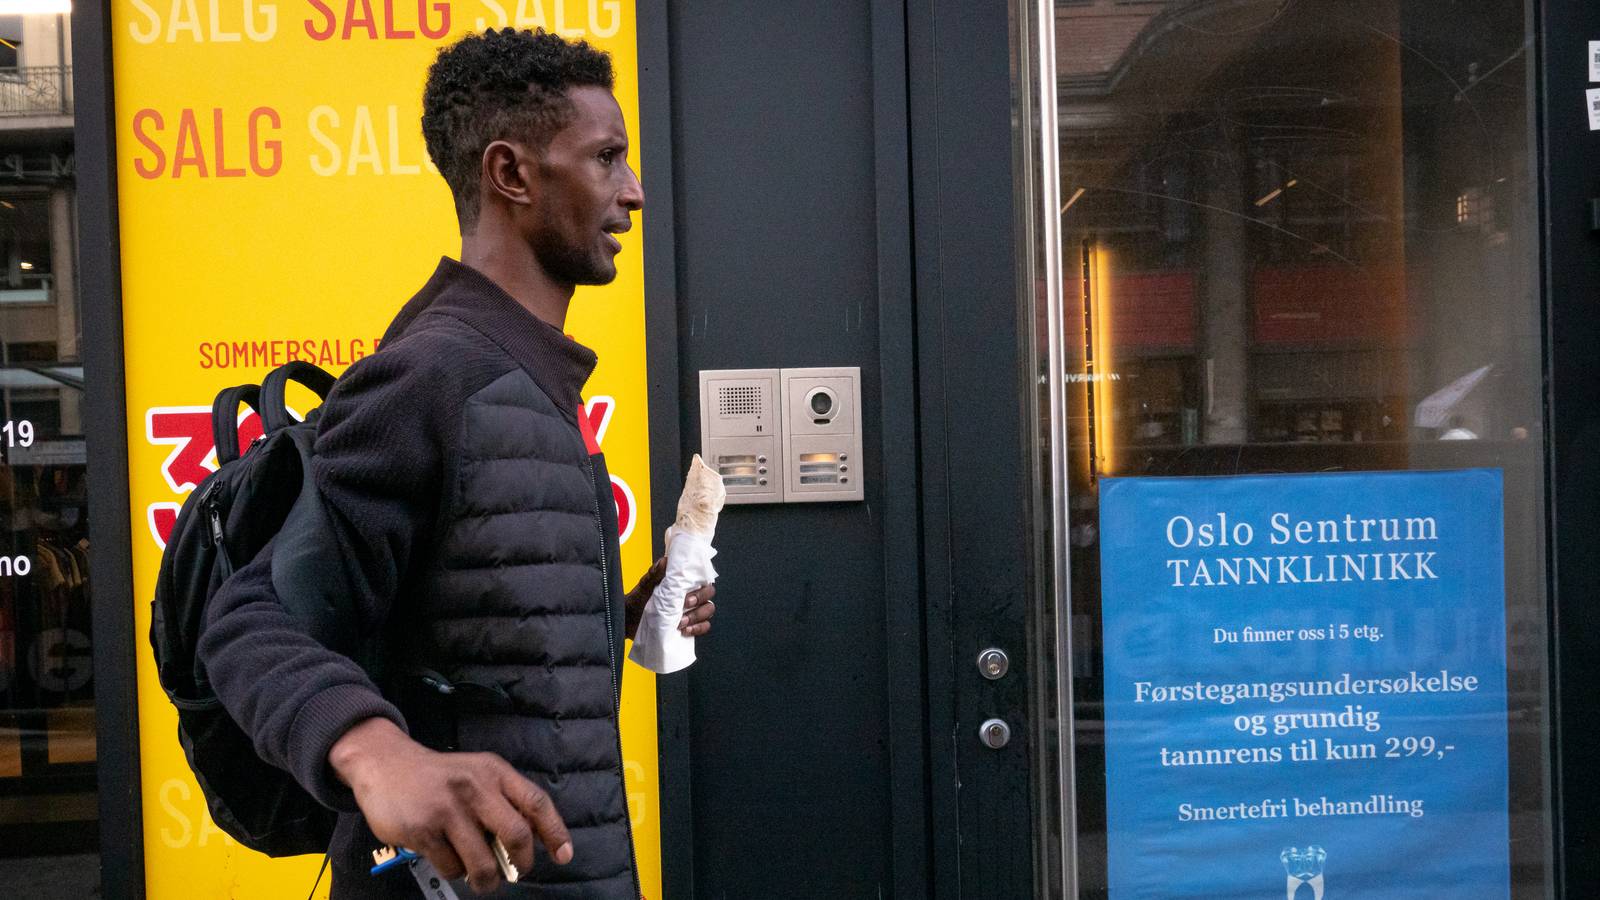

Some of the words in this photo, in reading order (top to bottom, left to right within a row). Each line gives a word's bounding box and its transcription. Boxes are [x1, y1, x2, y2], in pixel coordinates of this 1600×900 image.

[128, 0, 277, 44] SALG
[304, 0, 450, 41] SALG
[133, 107, 282, 180] SALG
[308, 104, 438, 177] SAL
[199, 338, 365, 369] SOMMERSALG
[1166, 512, 1254, 548] Oslo
[1270, 512, 1438, 545] Sentrum
[1166, 552, 1438, 587] TANNKLINIKK
[1213, 628, 1238, 643] Du
[1243, 626, 1294, 643] finner
[1298, 629, 1325, 641] oss
[1329, 624, 1335, 640] i
[1339, 624, 1350, 639] 5
[1353, 624, 1384, 642] etg.
[1134, 670, 1479, 705] Førstegangsundersøkelse
[1234, 714, 1268, 736] og
[1273, 705, 1381, 736] grundig
[1159, 747, 1282, 767] tannrens
[1289, 739, 1317, 762] til
[1325, 739, 1376, 760] kun
[1384, 736, 1455, 761] 299,-
[1178, 799, 1288, 821] Smertefri
[1293, 795, 1424, 818] behandling
